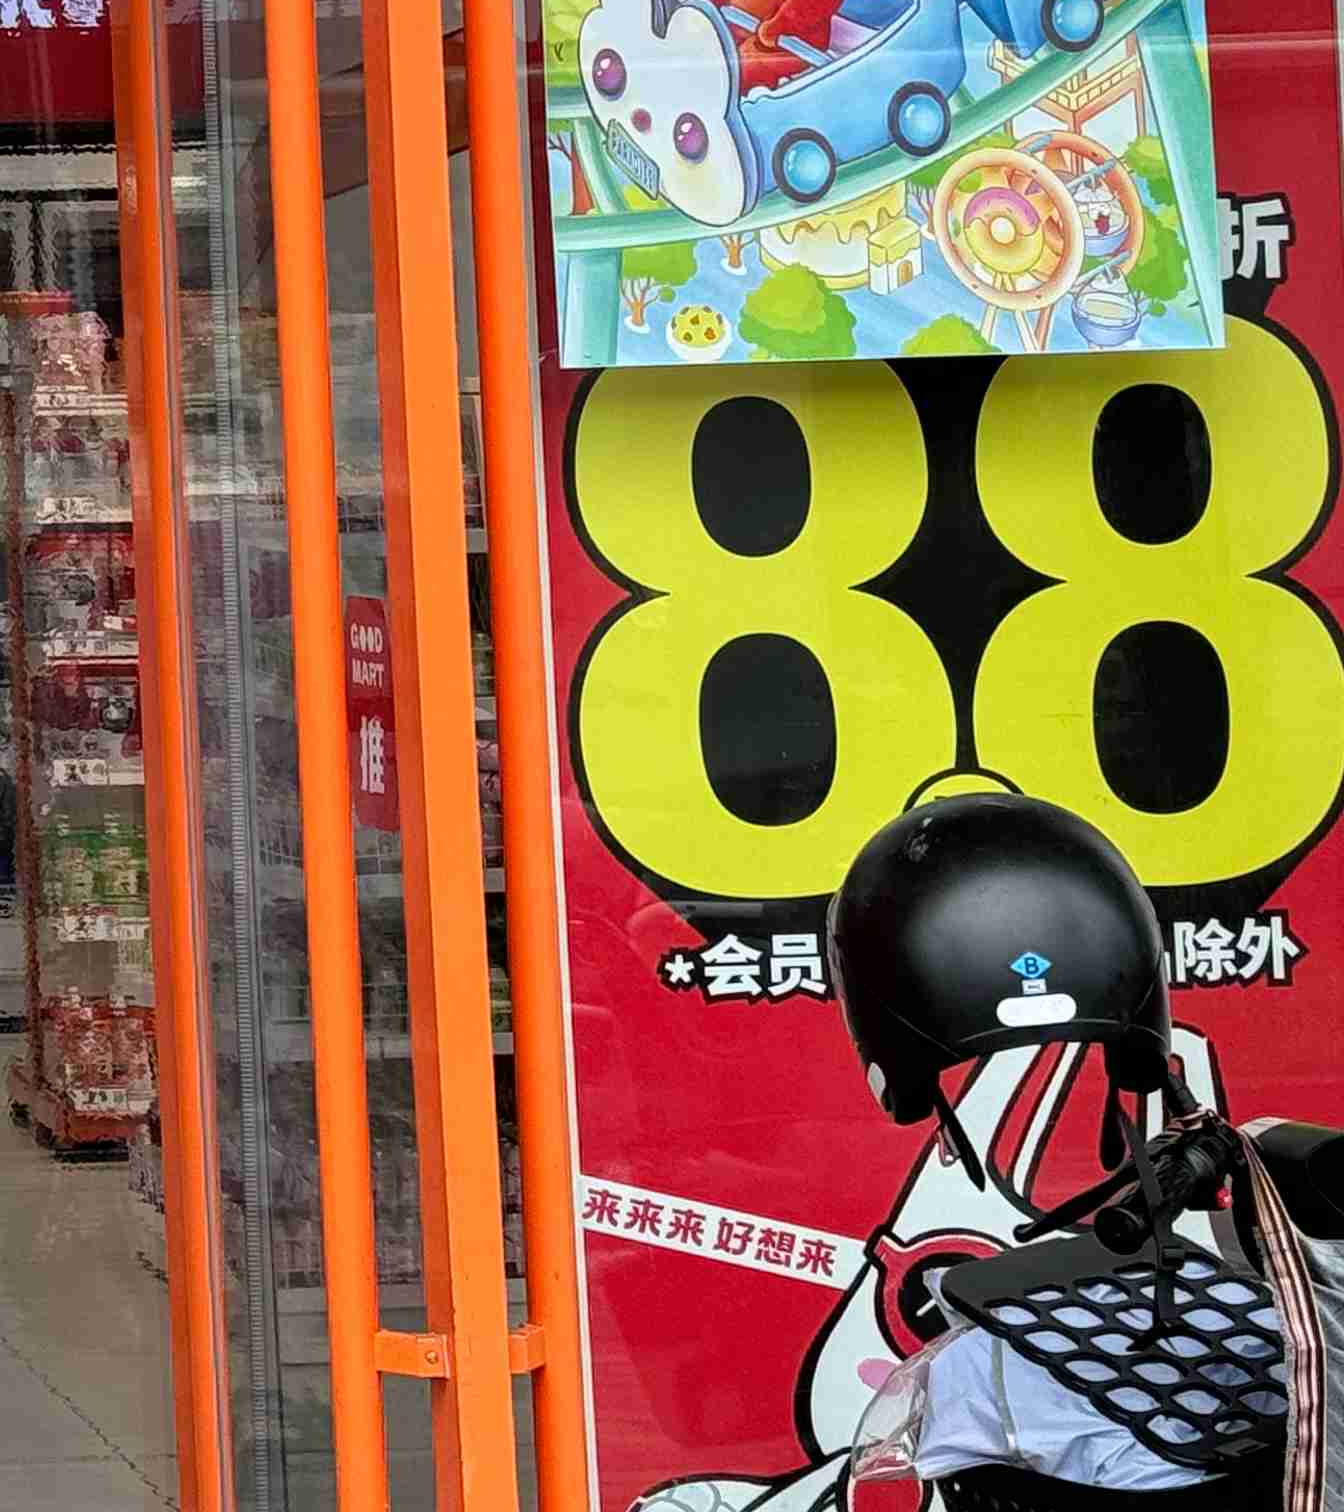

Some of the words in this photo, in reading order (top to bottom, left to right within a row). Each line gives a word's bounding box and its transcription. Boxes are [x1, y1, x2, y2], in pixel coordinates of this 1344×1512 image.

[575, 314, 1344, 900] 88
[350, 623, 383, 653] GOOD
[352, 658, 385, 688] MART
[1023, 956, 1040, 975] B
[1164, 916, 1301, 983] 除外
[582, 1188, 707, 1247] 来来来
[713, 1216, 838, 1277] 好想来
